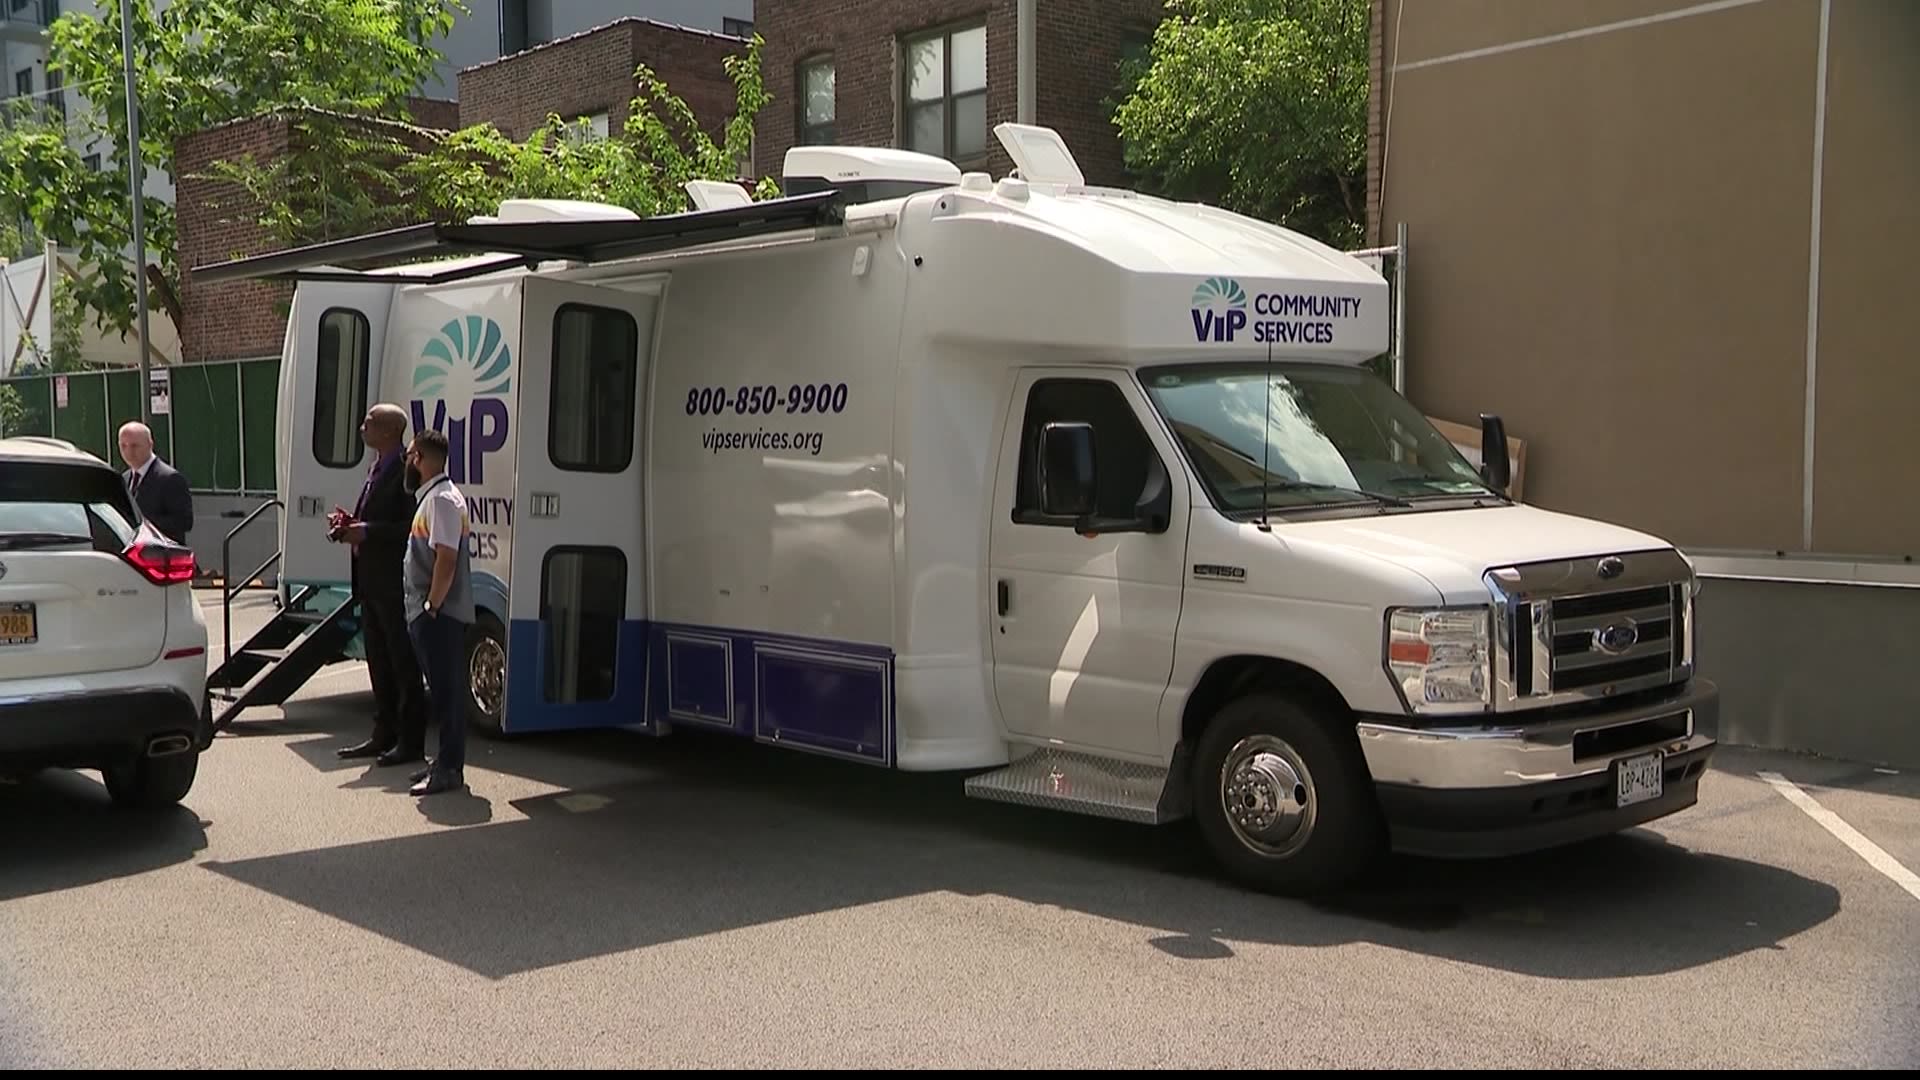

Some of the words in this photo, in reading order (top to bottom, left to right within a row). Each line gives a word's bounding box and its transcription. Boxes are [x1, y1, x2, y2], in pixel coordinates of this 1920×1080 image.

[1255, 294, 1361, 318] COMMUNITY
[1254, 321, 1333, 343] SERVICES
[685, 383, 848, 416] 800-850-9900
[702, 427, 823, 456] vipservices.org
